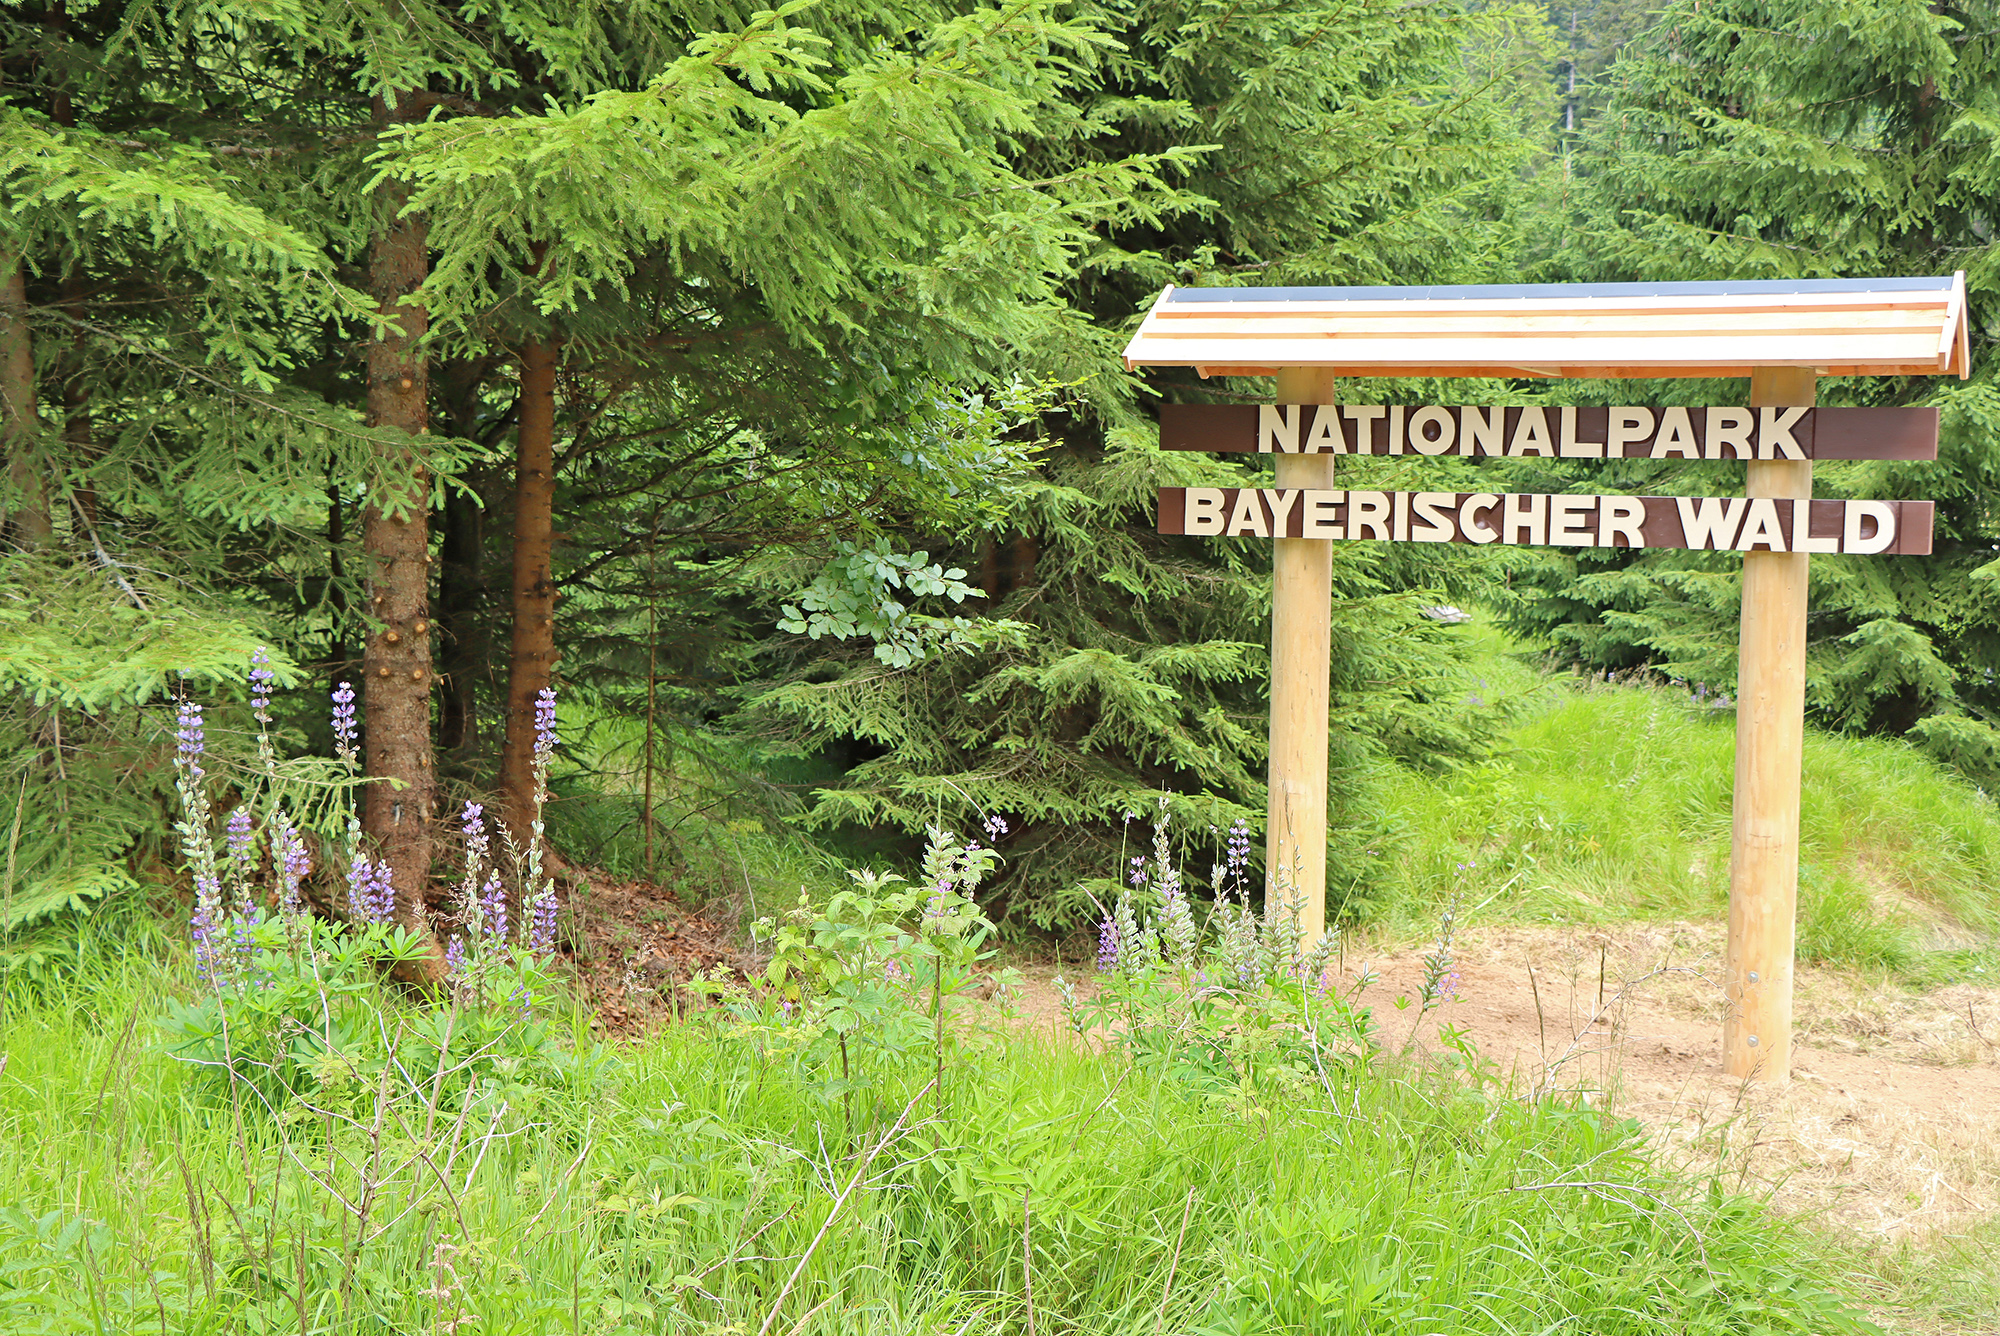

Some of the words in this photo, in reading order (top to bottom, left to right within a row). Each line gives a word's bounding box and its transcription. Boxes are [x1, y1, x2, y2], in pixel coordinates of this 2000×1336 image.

[1258, 404, 1811, 460] NATIONALPARK
[1184, 487, 1646, 549] BAYERISCHER
[1677, 496, 1896, 555] WALD
